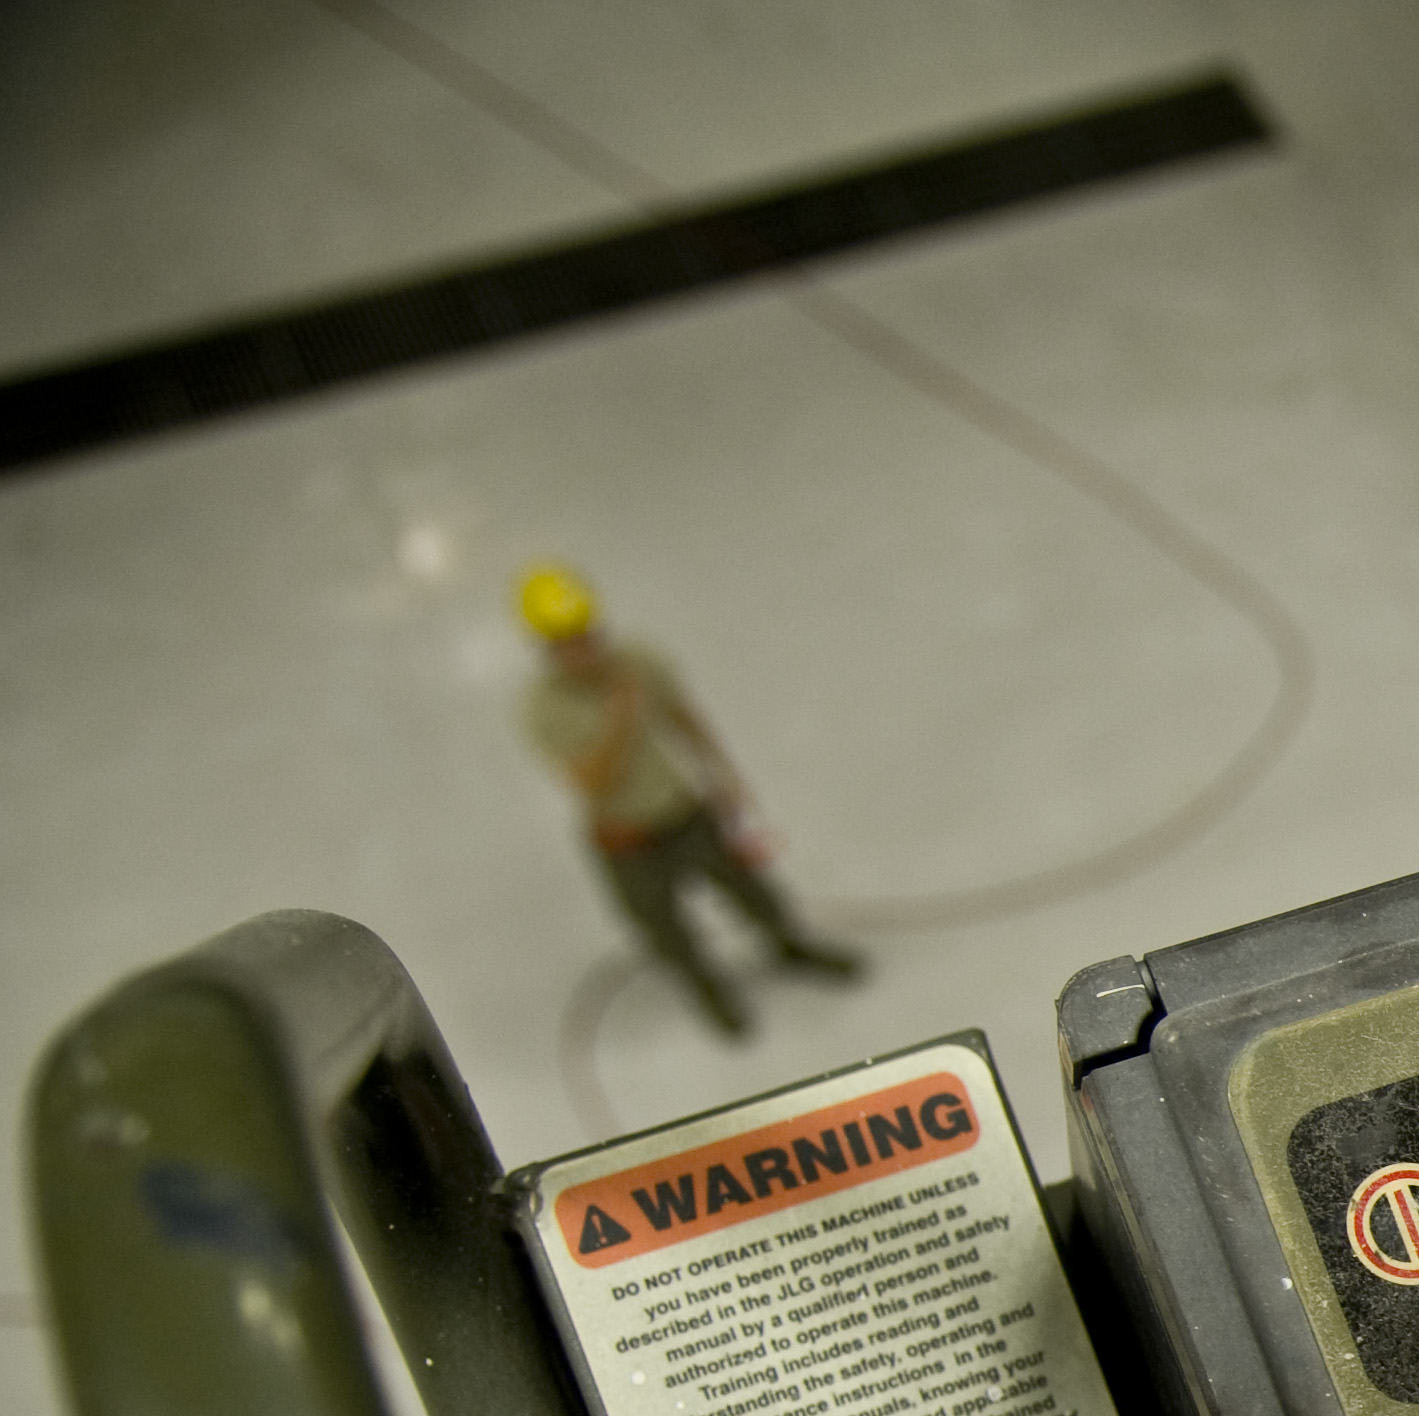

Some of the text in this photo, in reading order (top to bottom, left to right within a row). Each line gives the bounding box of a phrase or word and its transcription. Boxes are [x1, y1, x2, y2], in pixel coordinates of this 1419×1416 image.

[631, 1092, 973, 1231] WARNING
[610, 1172, 981, 1300] DO NOT OPERATE THIS MACHINE UNLESS
[613, 1215, 1013, 1353] described in the JLG operation and safety
[643, 1205, 968, 1321] you have been properly trained as
[664, 1326, 737, 1361] manual
[740, 1320, 766, 1336] by
[770, 1314, 783, 1327] a
[873, 1263, 940, 1296] person
[944, 1247, 980, 1270] and
[698, 1296, 981, 1401] Training includes reading and
[770, 1336, 791, 1351] to
[795, 1311, 868, 1344] operate
[871, 1298, 908, 1318] this
[912, 1270, 999, 1305] machine.
[802, 1372, 835, 1391] the
[905, 1319, 996, 1357] operating
[999, 1303, 1035, 1326] and
[832, 1361, 945, 1406] instructions
[953, 1352, 973, 1366] in
[976, 1340, 1008, 1359] the
[919, 1368, 1001, 1403] knowing
[1004, 1352, 1048, 1377] your
[951, 1376, 1049, 1416] appable
